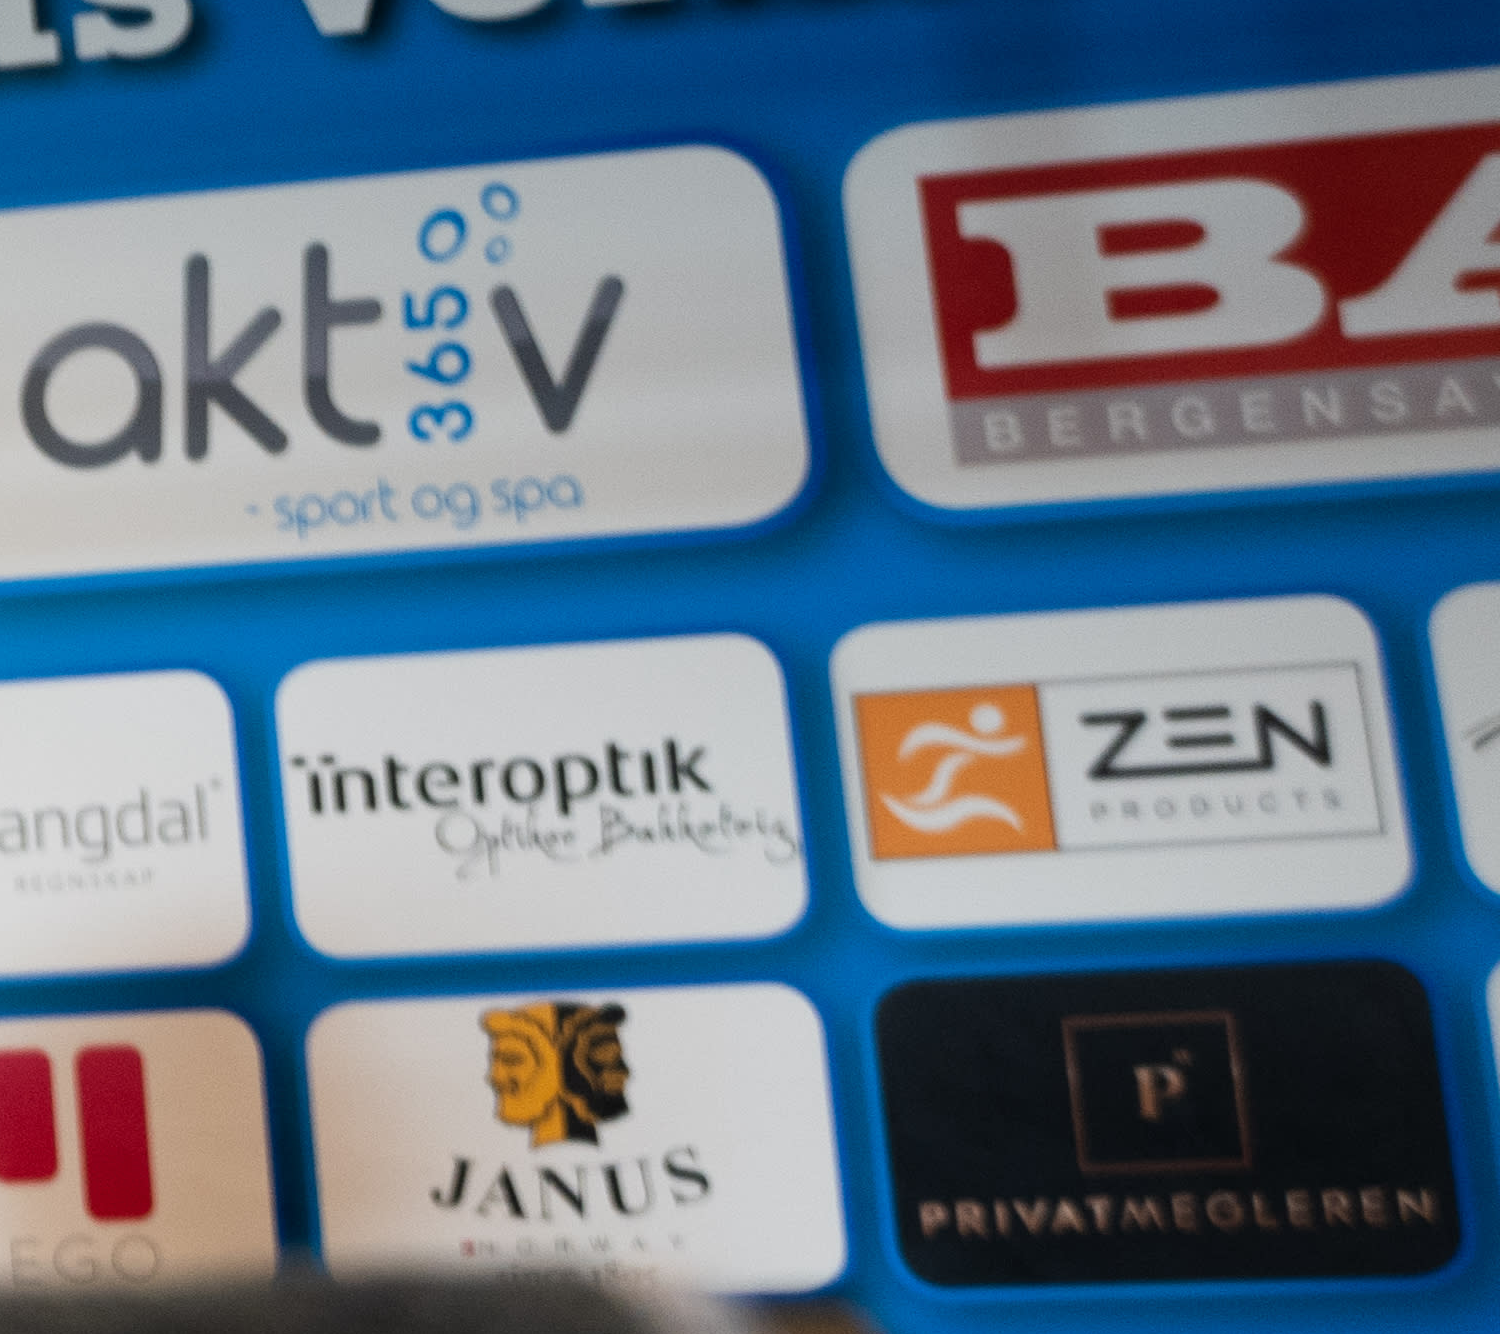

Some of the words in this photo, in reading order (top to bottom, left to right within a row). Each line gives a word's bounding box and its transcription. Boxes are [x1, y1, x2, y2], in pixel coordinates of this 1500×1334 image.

[982, 369, 1500, 454] BERGENSA
[274, 478, 398, 538] sport
[411, 478, 481, 527] og
[492, 474, 584, 524] spa
[1080, 699, 1334, 781] ZEN
[430, 1146, 712, 1220] JANUS
[918, 1187, 1443, 1241] PRIVATMEGLEREN
